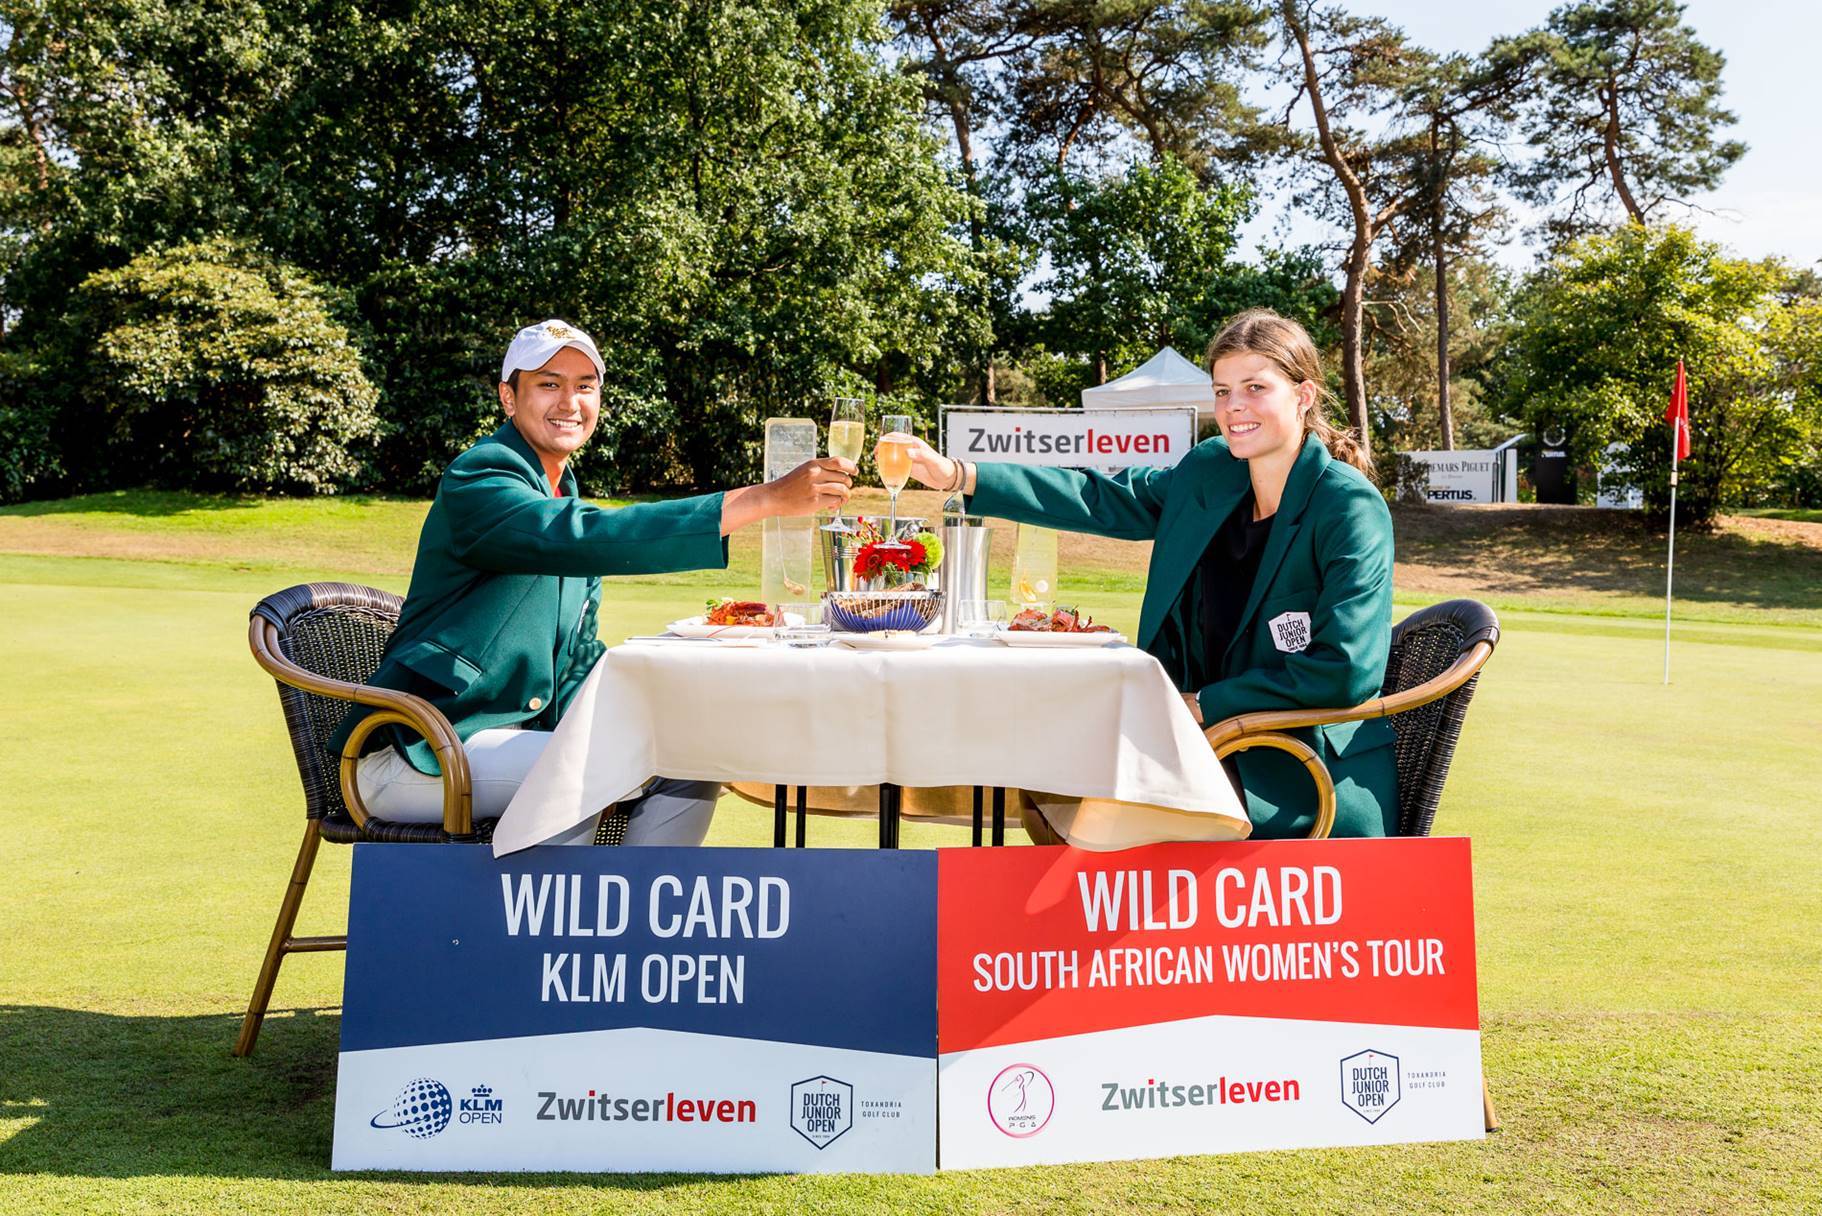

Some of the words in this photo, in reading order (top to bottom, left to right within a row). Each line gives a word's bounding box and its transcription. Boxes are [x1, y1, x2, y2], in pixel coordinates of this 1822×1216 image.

[968, 427, 1169, 454] Zwitserleven
[1461, 461, 1489, 472] PIGUET
[1277, 619, 1304, 633] DUTCH
[1280, 626, 1307, 641] JUNIOR
[1286, 635, 1306, 648] OPEN
[1077, 868, 1198, 932] WILD
[1215, 866, 1342, 929] CARD
[501, 874, 630, 937] WILD
[649, 875, 790, 939] CARD
[973, 951, 1078, 993] SOUTH
[1088, 946, 1214, 988] AFRICAN
[1222, 941, 1359, 981] WOMEN'S
[1366, 938, 1445, 976] TOUR
[541, 953, 627, 1003] KLM
[641, 953, 745, 1004] OPEN
[1352, 1066, 1388, 1081] DUTCH
[1101, 1076, 1300, 1111] Zwitserleven
[1352, 1080, 1389, 1094] JUNIOR
[459, 1099, 503, 1112] KLM
[536, 1090, 756, 1123] Zwitserleven
[803, 1093, 840, 1107] DUTCH
[1357, 1093, 1385, 1107] OPEN
[459, 1112, 503, 1124] OPEN
[801, 1106, 841, 1119] JUNIOR
[807, 1119, 835, 1132] OPEN
